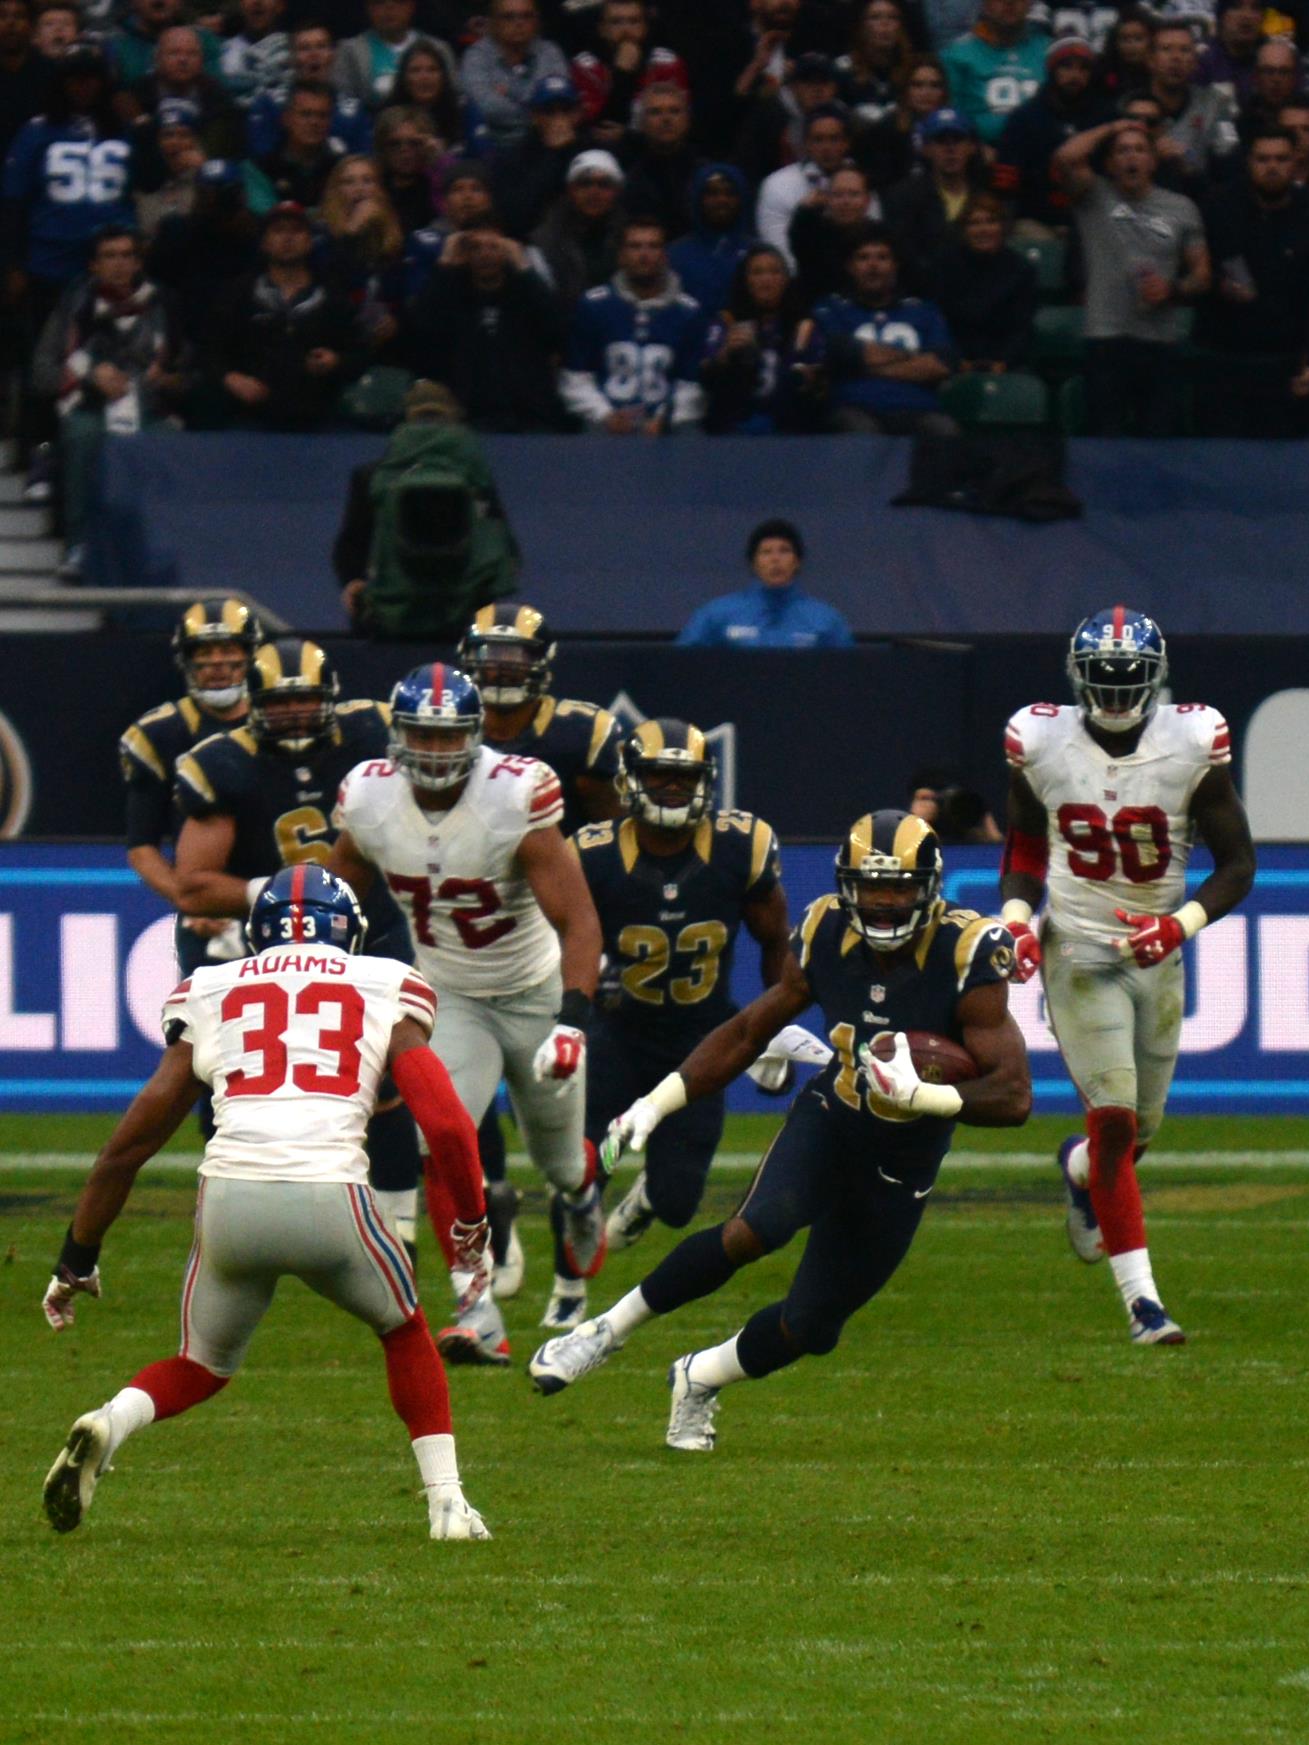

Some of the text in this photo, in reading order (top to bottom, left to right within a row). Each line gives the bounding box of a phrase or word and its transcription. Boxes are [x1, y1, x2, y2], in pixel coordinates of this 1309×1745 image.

[46, 139, 131, 203] 56
[1102, 624, 1133, 640] 90
[422, 689, 453, 706] 72
[1057, 803, 1172, 884] 90
[280, 917, 316, 938] 33
[386, 871, 518, 949] 72
[239, 954, 347, 978] ADAMS
[618, 919, 728, 1005] 23
[220, 981, 365, 1104] 33
